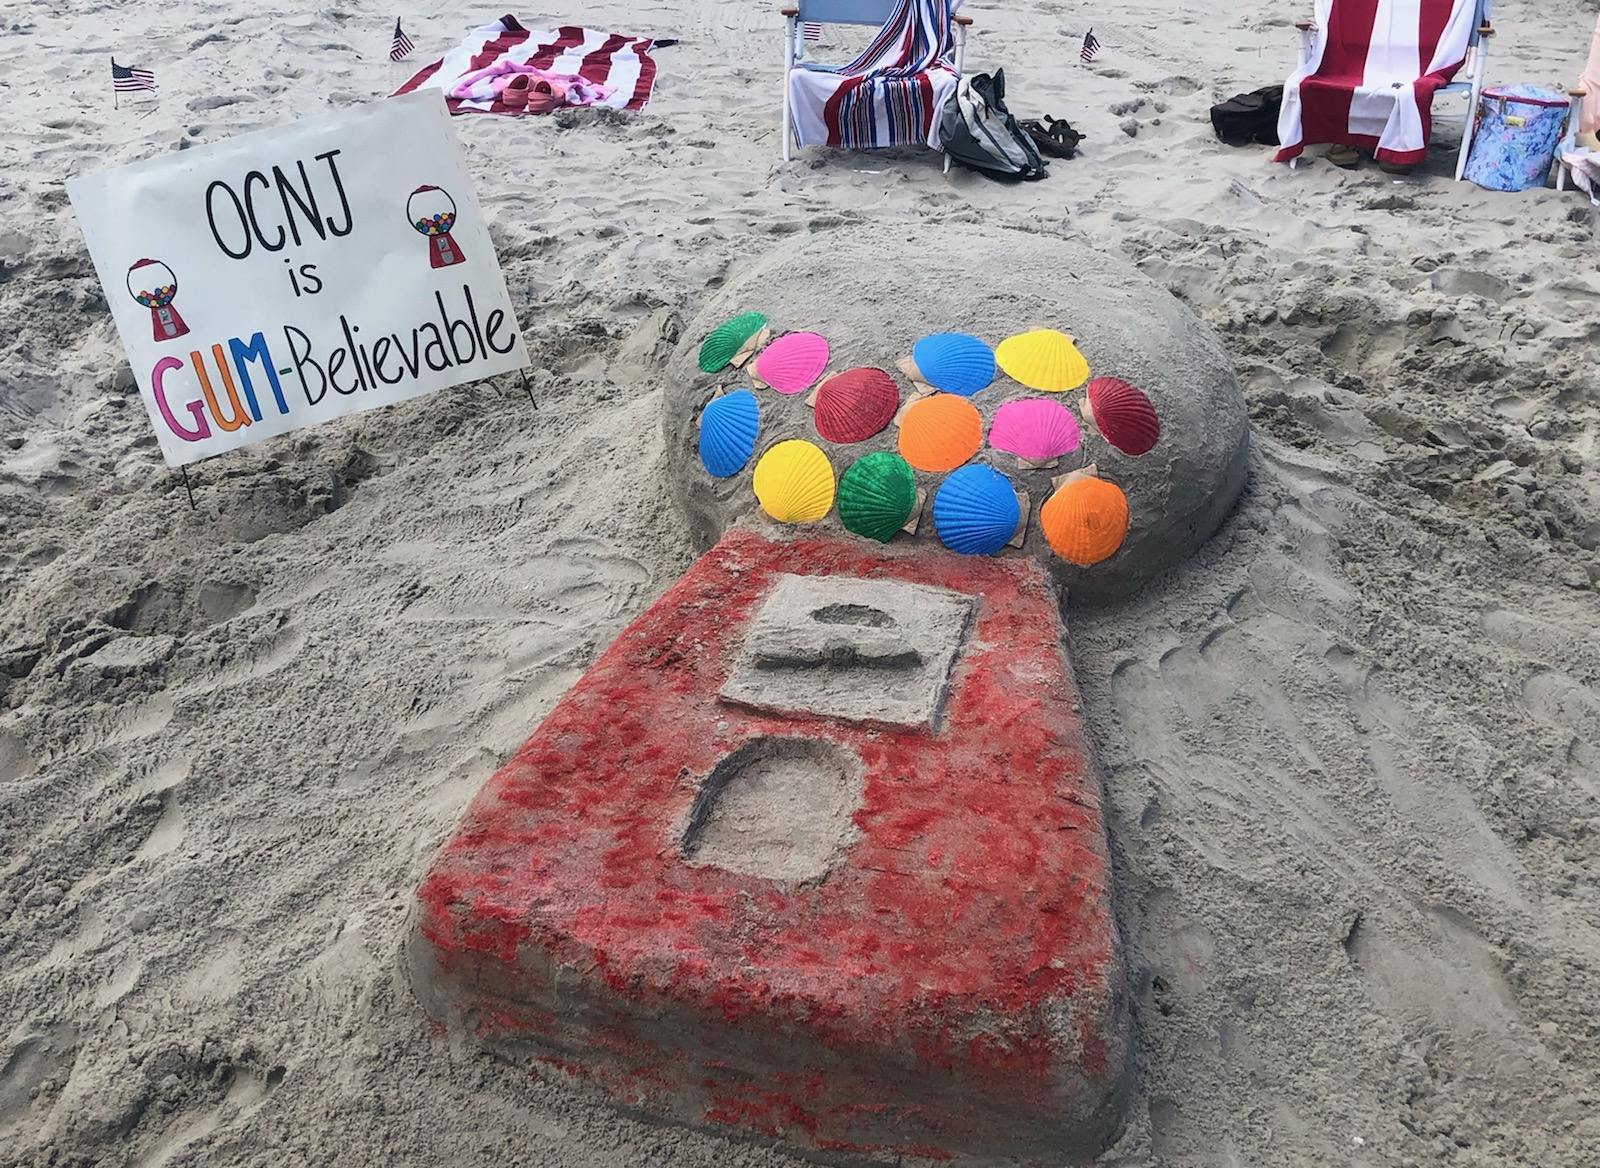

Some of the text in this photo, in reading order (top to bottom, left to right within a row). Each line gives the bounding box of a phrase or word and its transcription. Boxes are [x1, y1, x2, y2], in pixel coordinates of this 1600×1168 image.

[205, 149, 353, 260] OCNJ
[284, 258, 323, 297] is
[151, 284, 516, 442] GUM-Believable
